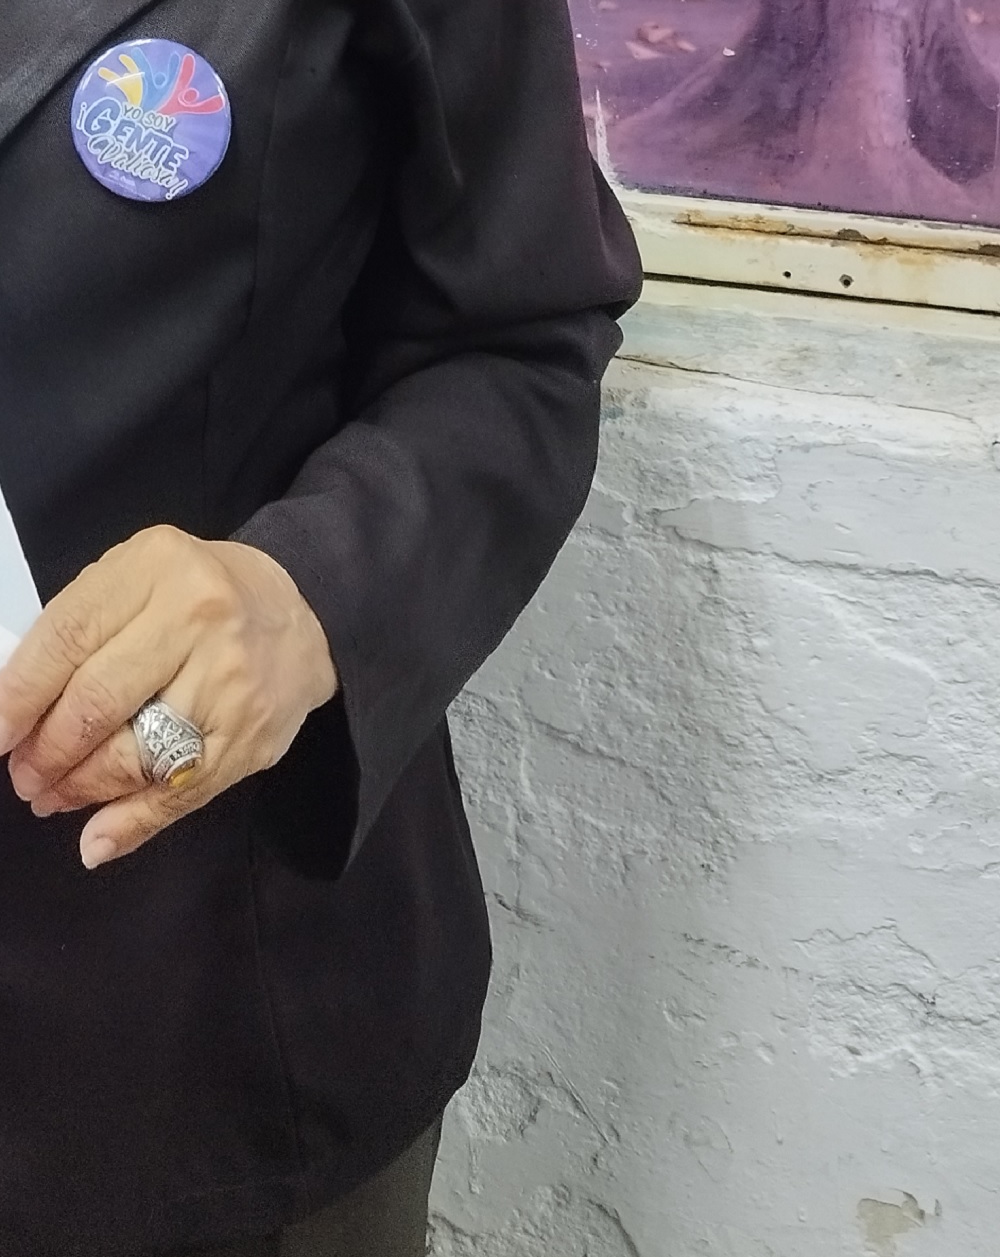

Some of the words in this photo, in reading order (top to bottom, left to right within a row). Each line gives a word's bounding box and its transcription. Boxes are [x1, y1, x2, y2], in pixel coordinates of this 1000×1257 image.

[123, 103, 142, 120] YO
[143, 111, 175, 131] SOY
[88, 135, 188, 200] Valiosa!
